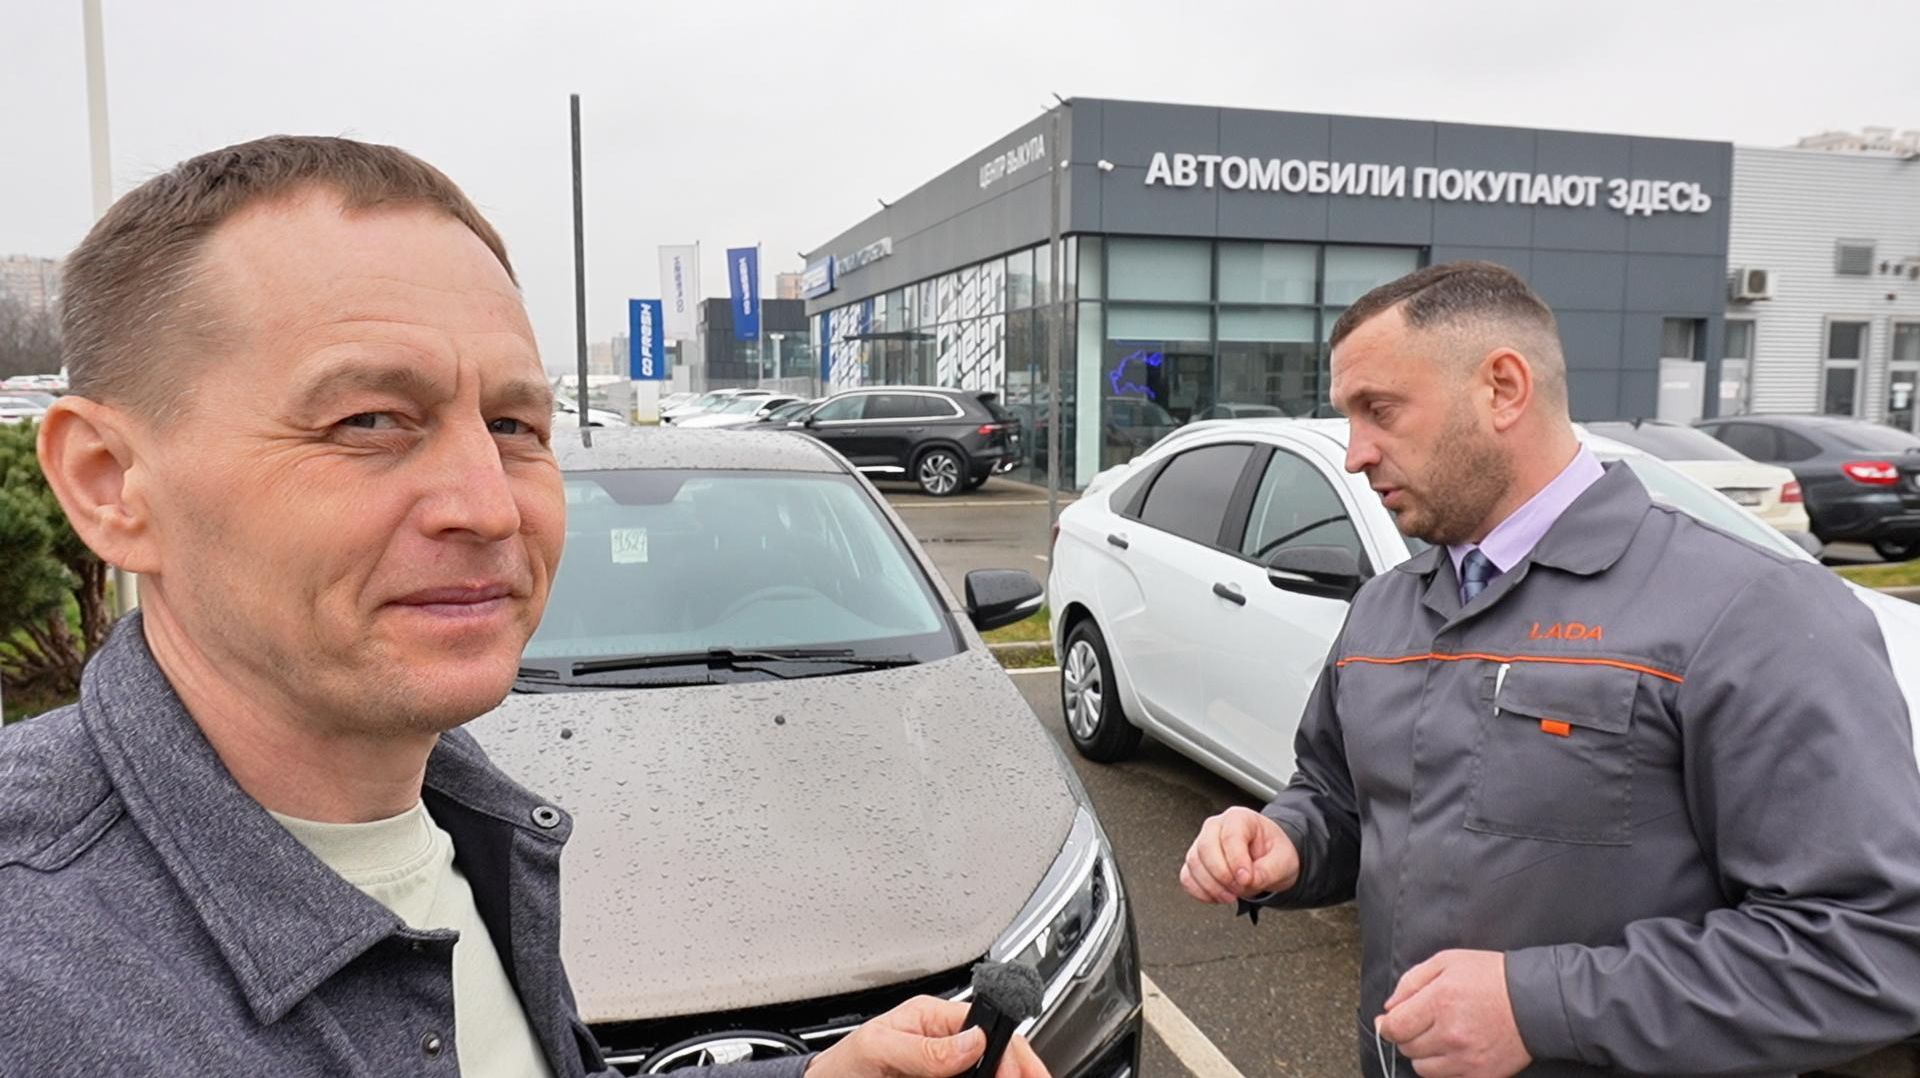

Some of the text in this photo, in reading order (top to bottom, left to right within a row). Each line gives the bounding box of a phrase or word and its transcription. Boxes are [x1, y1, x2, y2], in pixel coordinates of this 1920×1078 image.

[1006, 133, 1046, 175] ВЫКУПА
[1144, 152, 1712, 216] АВТОМОБИЛИ ПОКУПАЮТ ЗДЕСЬ
[1528, 622, 1603, 641] LADA
